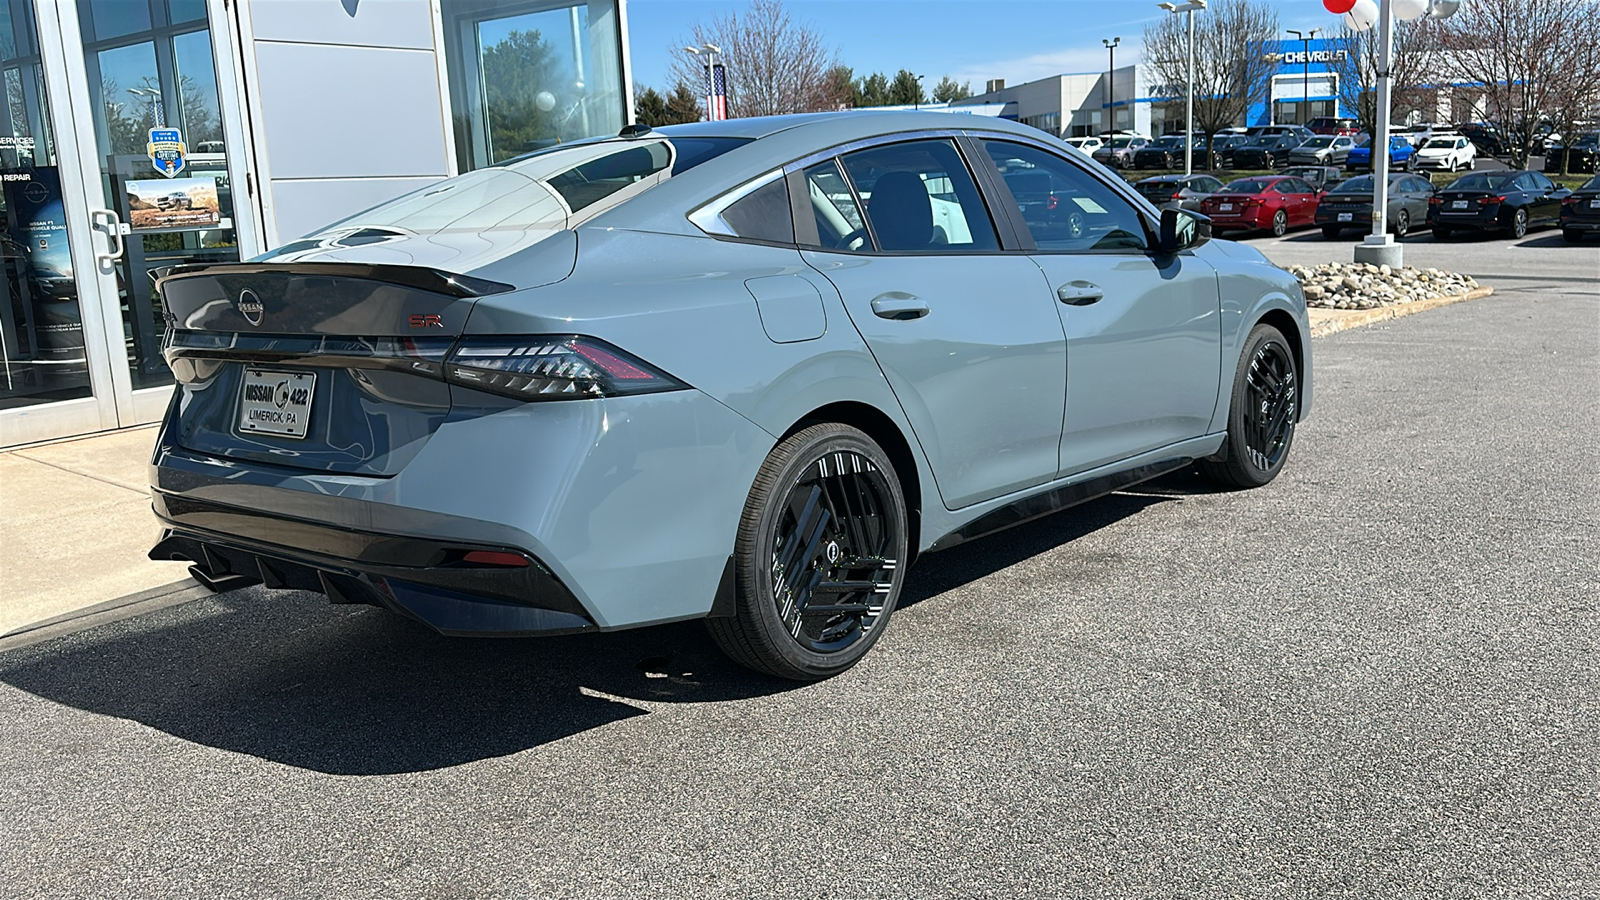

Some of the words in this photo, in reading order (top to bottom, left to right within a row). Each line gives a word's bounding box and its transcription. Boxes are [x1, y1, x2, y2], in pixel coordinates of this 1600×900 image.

[1285, 50, 1348, 63] CHEVROLET
[408, 314, 444, 328] SR
[245, 384, 275, 403] NISSAN
[290, 387, 308, 406] 422
[249, 409, 284, 424] LIMERICK,
[286, 413, 298, 424] PA
